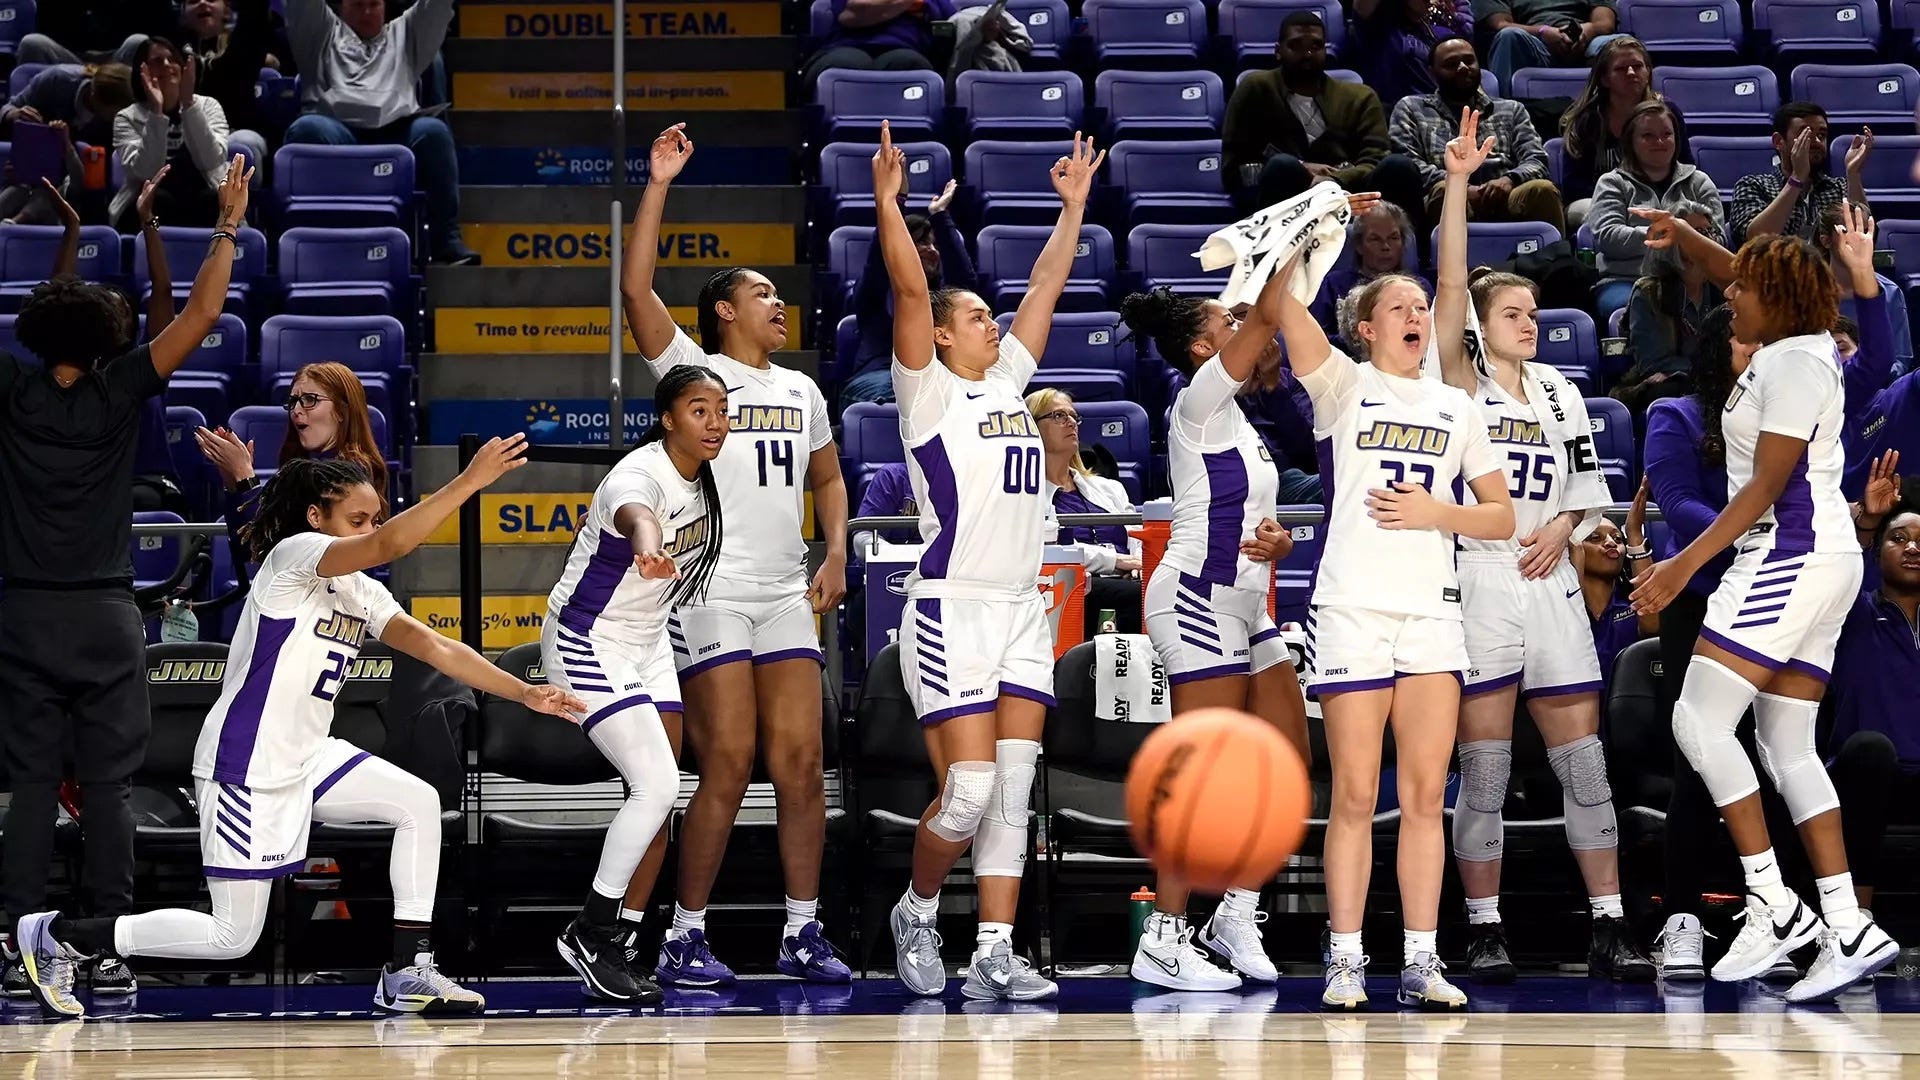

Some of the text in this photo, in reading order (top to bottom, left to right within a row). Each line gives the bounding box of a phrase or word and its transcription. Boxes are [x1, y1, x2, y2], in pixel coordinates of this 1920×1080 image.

[639, 12, 736, 35] TEAM.
[624, 86, 645, 98] nd
[475, 322, 628, 336] Time to reevaluae
[1555, 329, 1564, 340] 5
[363, 336, 377, 347] 10
[1094, 332, 1103, 343] 2
[729, 405, 803, 433] JMU
[1357, 420, 1451, 457] JMU
[1487, 416, 1550, 448] JM
[755, 440, 793, 487] 14
[1003, 446, 1041, 495] 00
[1507, 451, 1556, 501] 35
[1299, 527, 1307, 539] 3
[147, 537, 155, 548] 6
[427, 613, 461, 628] Sav
[481, 612, 511, 631] 5%
[698, 641, 721, 655] DUKES
[1115, 636, 1128, 678] READY
[150, 661, 226, 681] JMU
[1324, 667, 1349, 676] DUKES
[1151, 660, 1164, 706] READY
[960, 687, 984, 698] DUKES
[261, 853, 285, 862] DUKES
